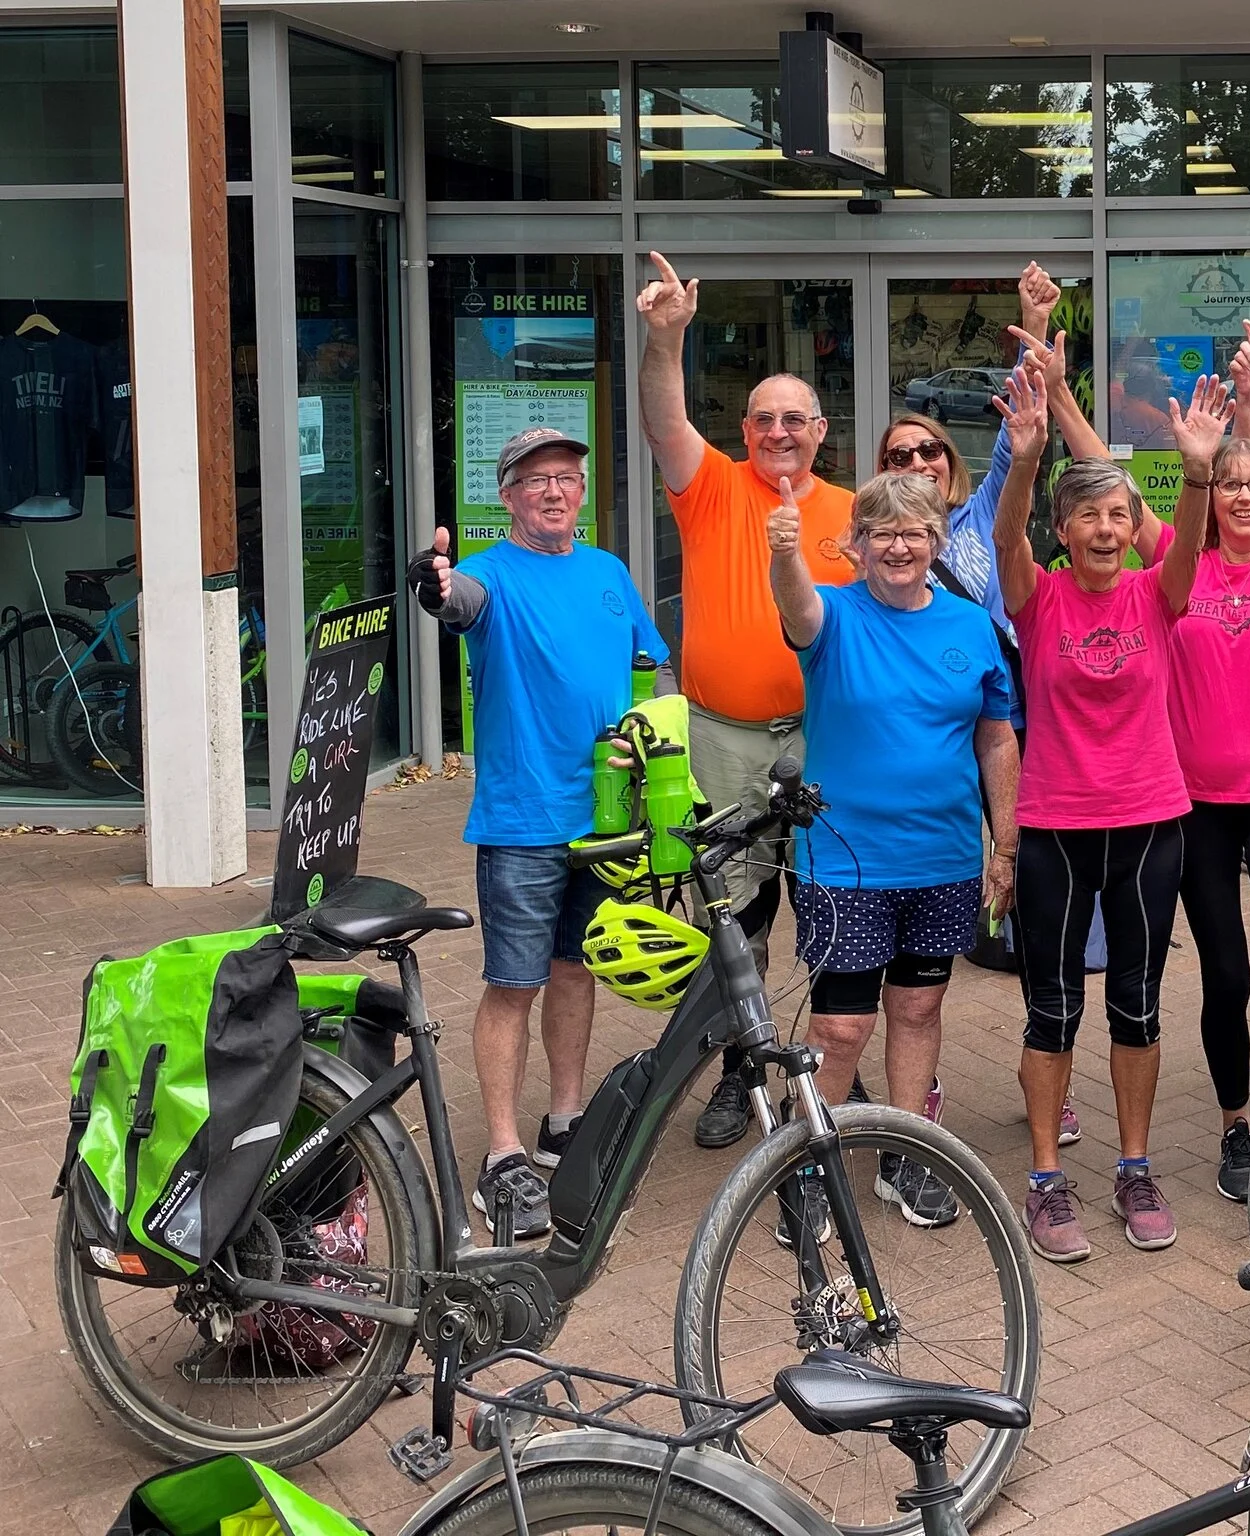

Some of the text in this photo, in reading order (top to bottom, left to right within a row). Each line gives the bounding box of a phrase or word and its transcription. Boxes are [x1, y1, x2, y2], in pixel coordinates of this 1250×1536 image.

[493, 295, 587, 311] BIKE HIRE
[1204, 295, 1250, 305] Journeys
[526, 389, 588, 398] ADVENTURES!
[1154, 462, 1169, 472] Try
[465, 528, 506, 538] HIRE A
[319, 606, 390, 649] BIKE HIRE
[1188, 600, 1226, 618] GREAT
[310, 667, 338, 706] YES
[299, 688, 368, 746] RIDE LIKE
[308, 739, 360, 783] A GIRL
[284, 782, 332, 837] TRY TO
[297, 828, 331, 871] KEEP
[280, 1126, 330, 1175] Journeys
[148, 1170, 191, 1230] 0800 CYCLE TRAILS
[158, 1183, 174, 1206] Nelson
